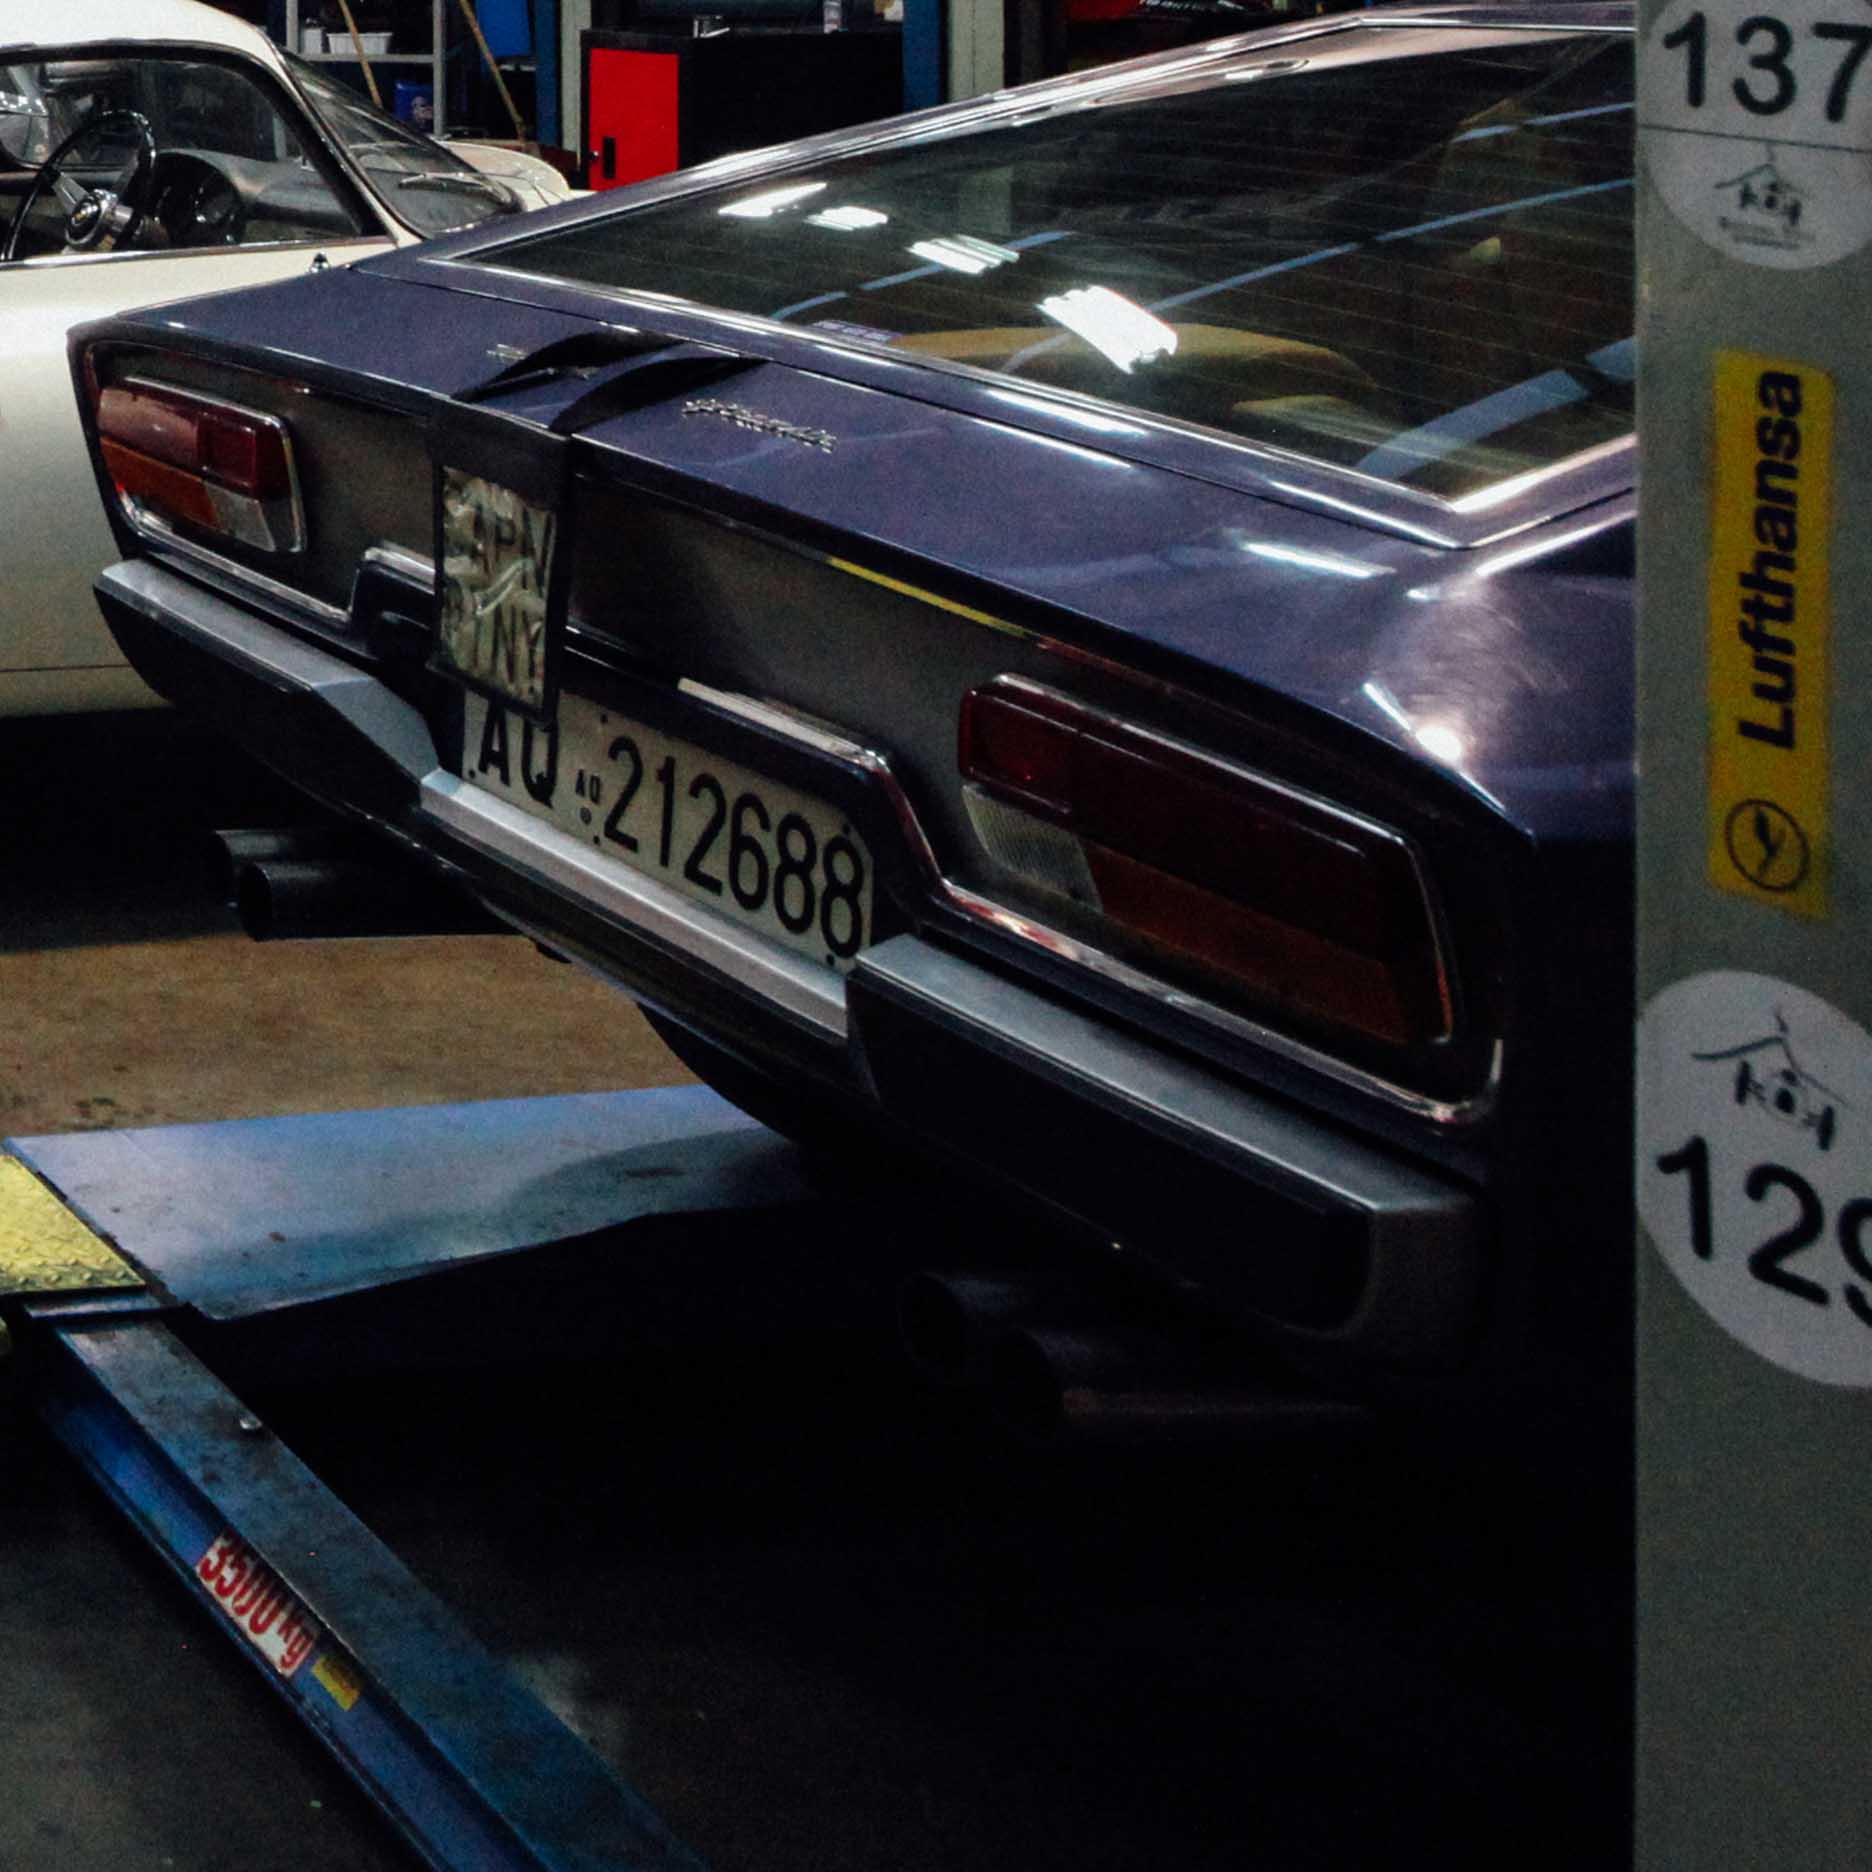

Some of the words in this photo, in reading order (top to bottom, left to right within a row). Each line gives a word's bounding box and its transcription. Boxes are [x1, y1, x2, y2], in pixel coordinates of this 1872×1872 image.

[1662, 11, 1872, 123] 137
[1737, 371, 1802, 750] Lufthansa
[603, 733, 865, 959] 212688
